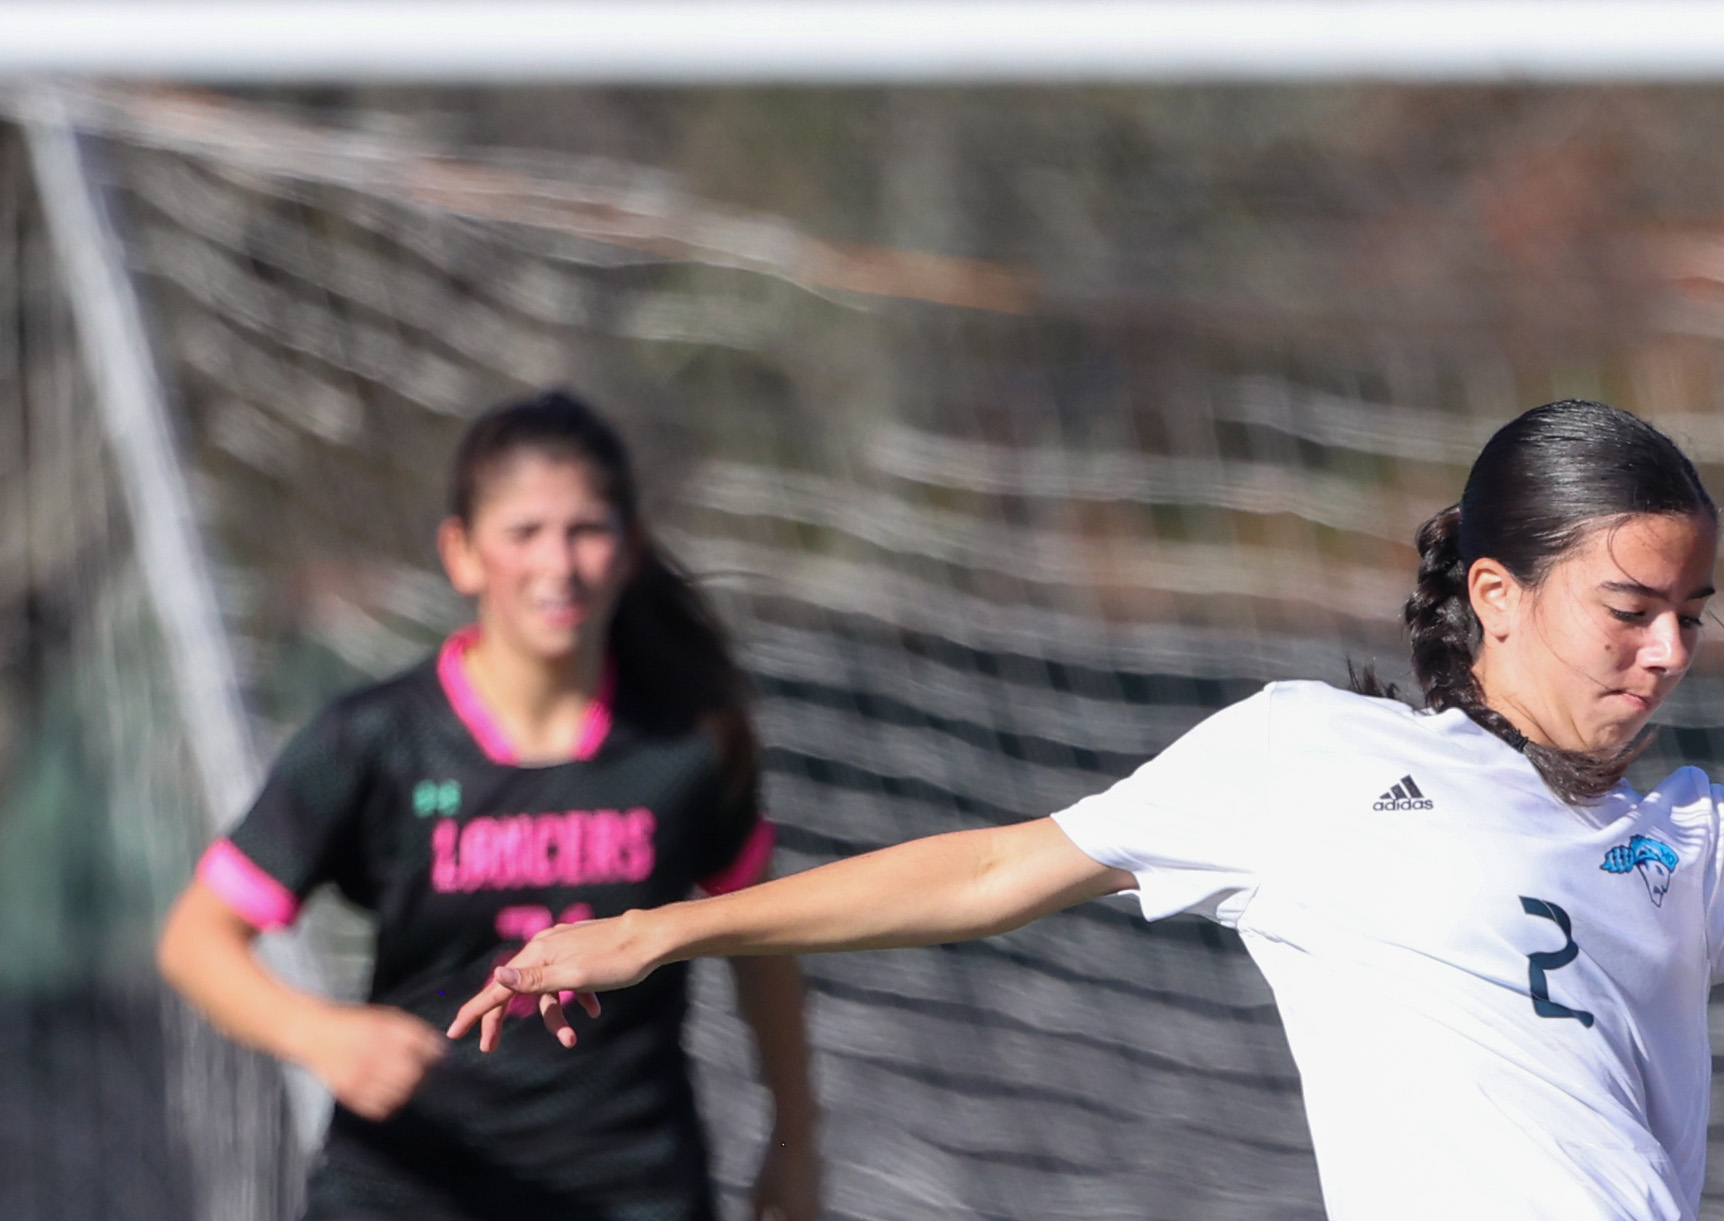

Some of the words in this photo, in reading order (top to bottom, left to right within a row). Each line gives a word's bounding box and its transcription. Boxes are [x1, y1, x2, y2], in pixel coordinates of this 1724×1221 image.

[1372, 797, 1434, 812] adidas
[432, 806, 657, 893] LANCERS
[1518, 894, 1595, 1029] 2
